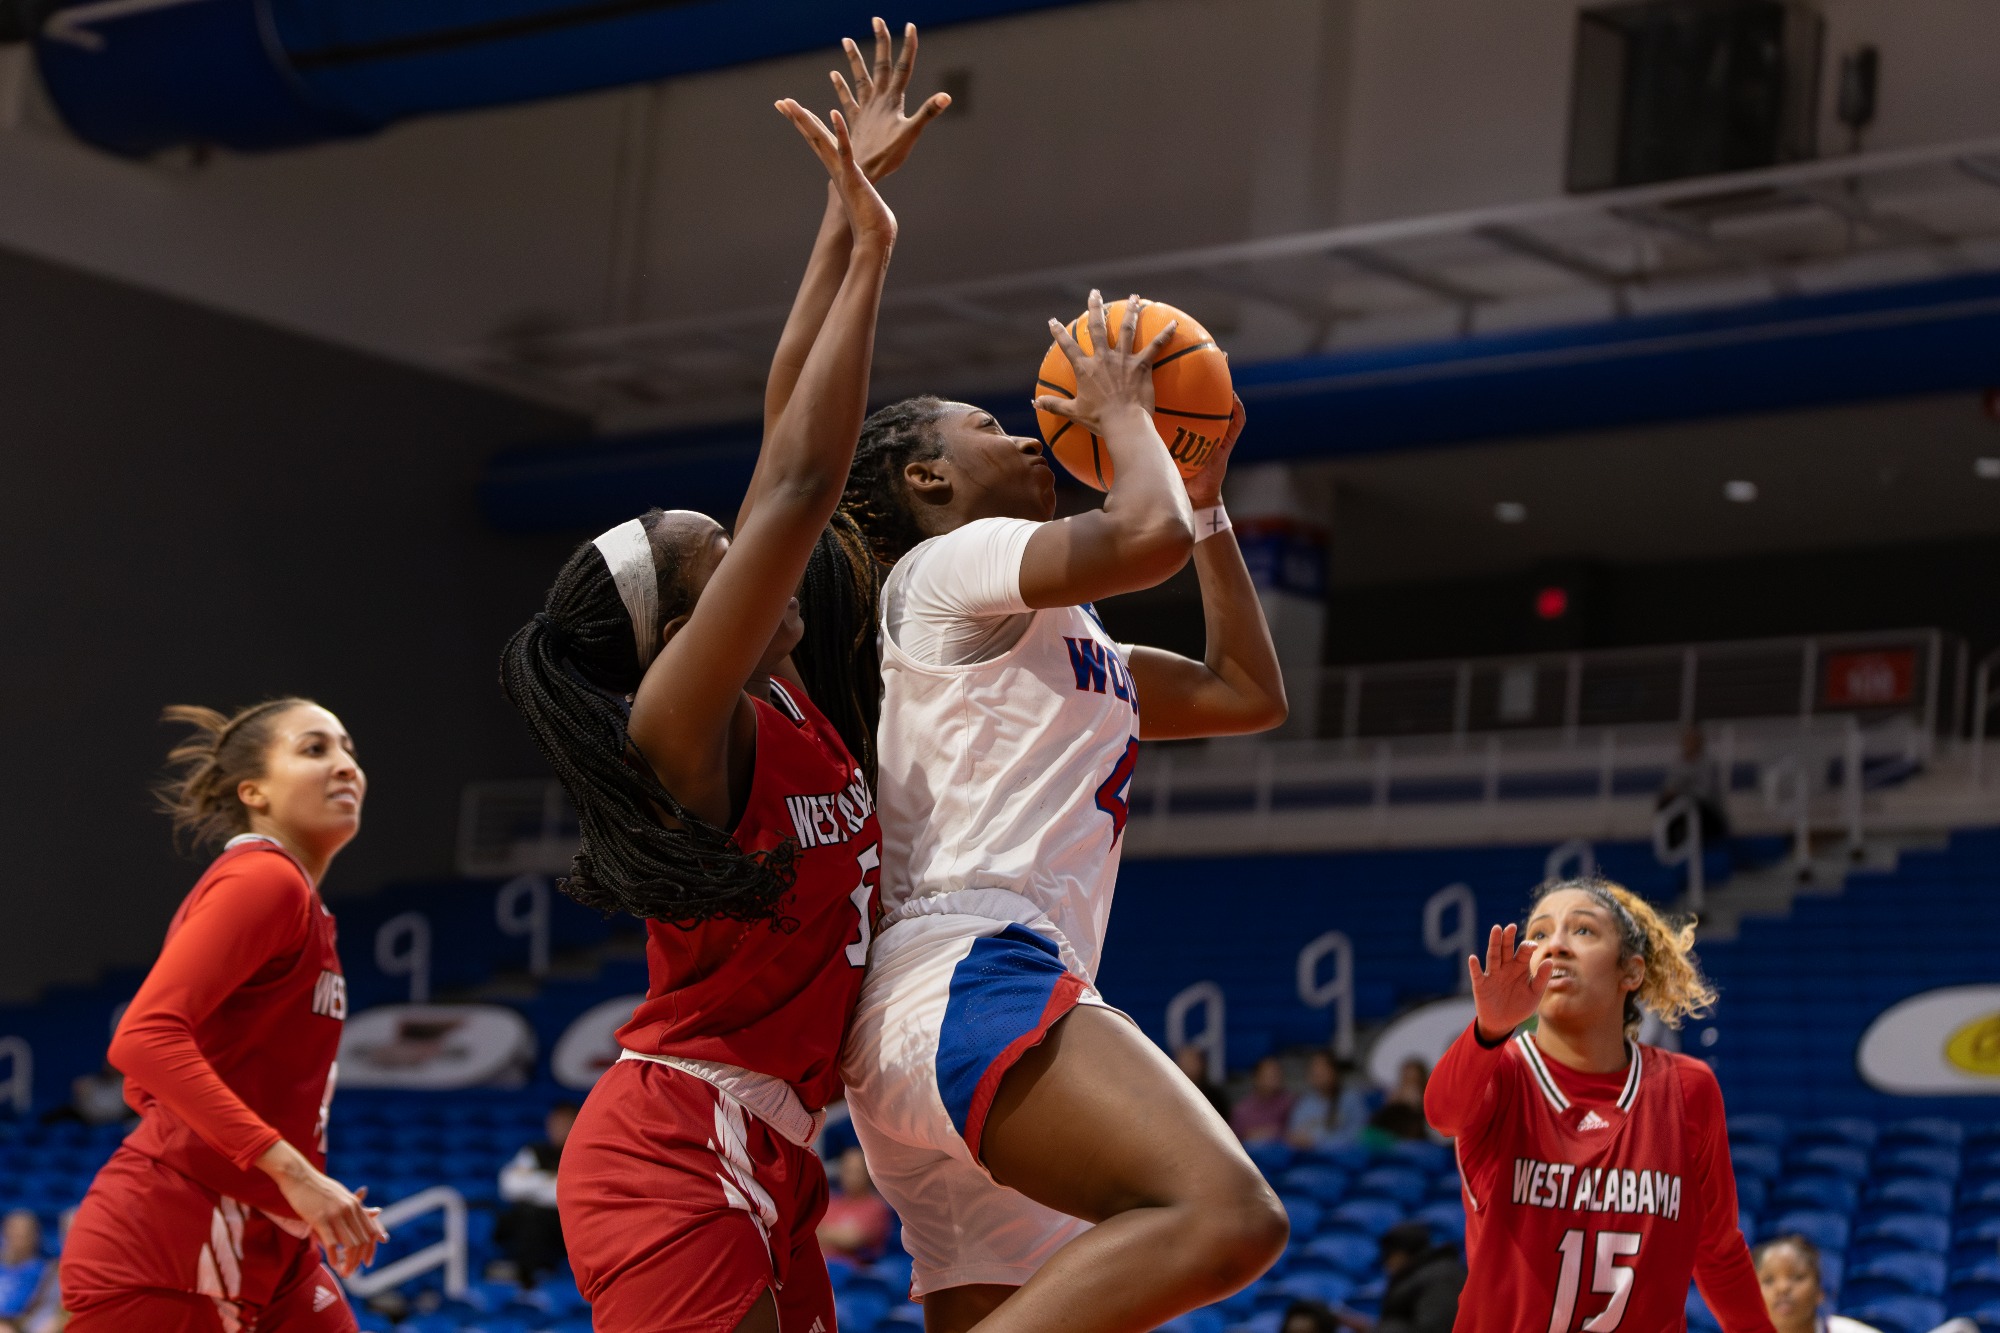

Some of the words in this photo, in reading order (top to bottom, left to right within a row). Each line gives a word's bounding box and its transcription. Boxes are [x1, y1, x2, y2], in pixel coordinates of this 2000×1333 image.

[1169, 425, 1220, 467] Wil
[1512, 1158, 1576, 1210] WEST
[1572, 1166, 1682, 1222] ALABAMA
[1547, 1229, 1643, 1333] 15
